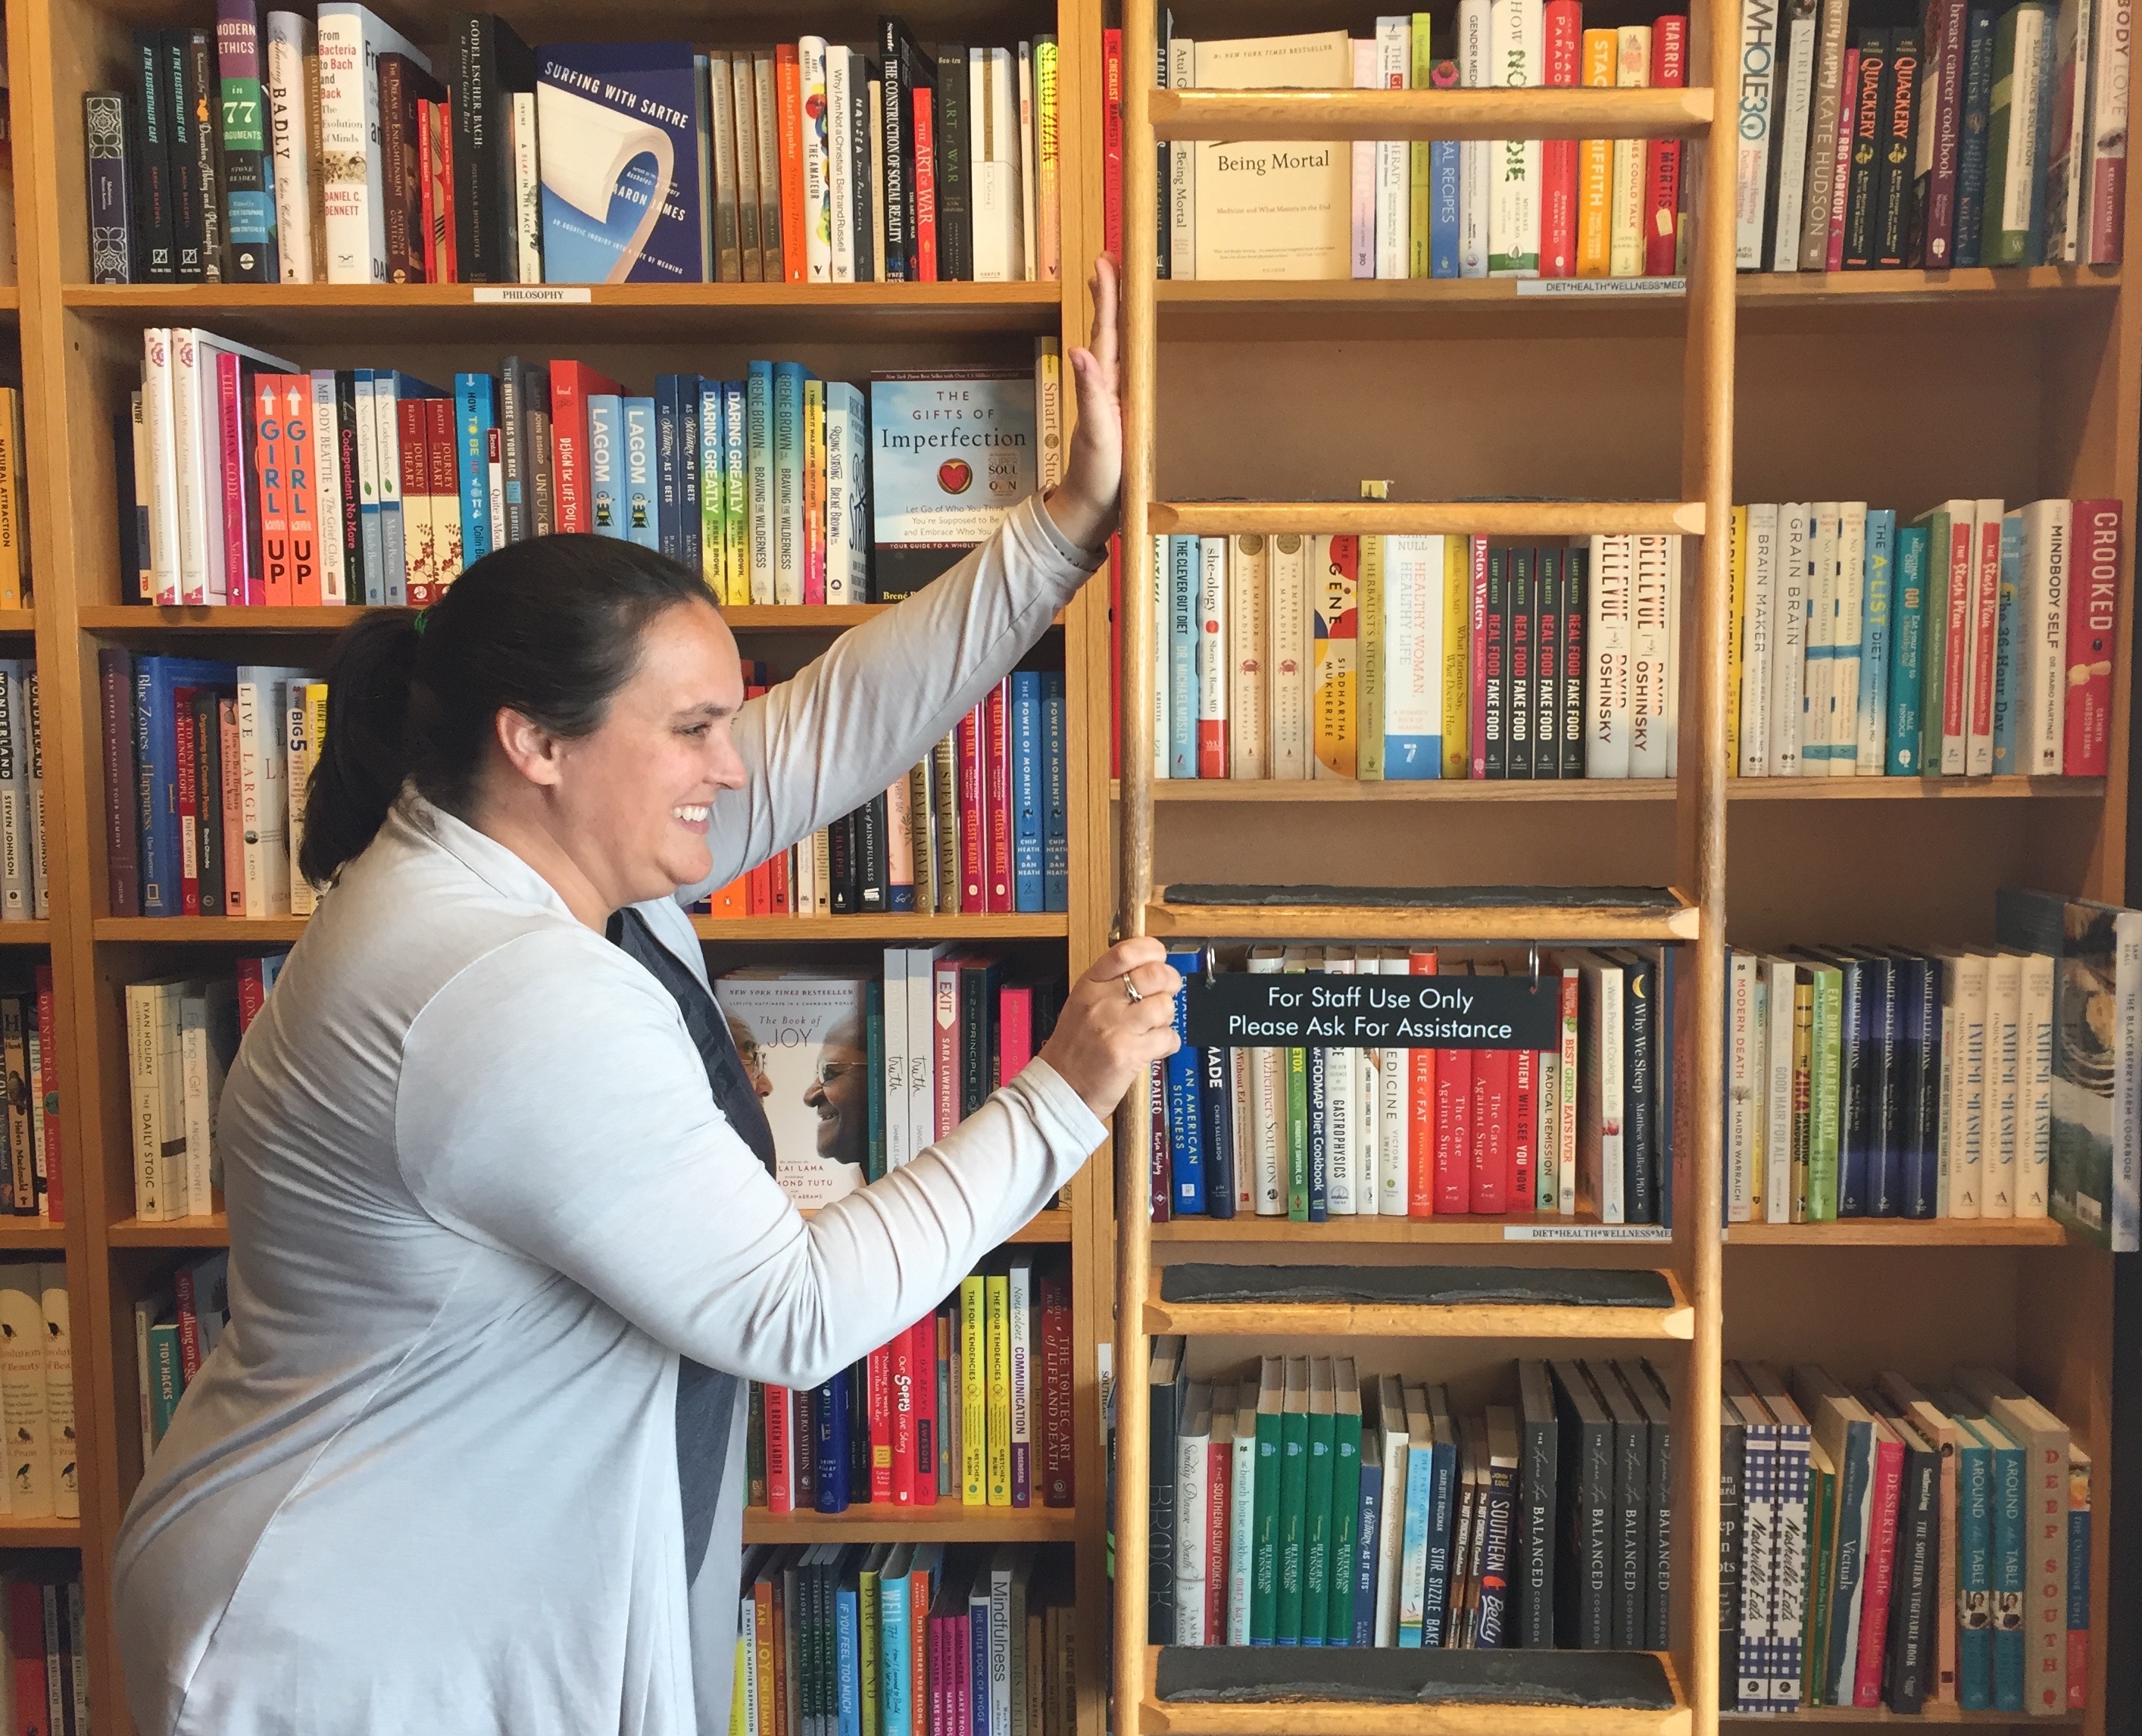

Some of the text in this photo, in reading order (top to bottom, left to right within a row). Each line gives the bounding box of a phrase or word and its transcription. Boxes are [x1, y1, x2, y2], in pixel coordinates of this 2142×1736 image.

[219, 42, 254, 54] ETHICS
[319, 30, 339, 41] From
[319, 44, 356, 55] Bacteria
[320, 59, 352, 70] to Bach
[1664, 22, 1681, 79] HARRIS
[223, 101, 256, 123] 77
[320, 73, 335, 84] and
[320, 88, 341, 98] Back
[545, 61, 688, 129] SURFING WITH SARTRE
[1859, 57, 1884, 140] QUACKERY
[1893, 57, 1917, 139] QUACKERY
[1938, 4, 1964, 179] breast cancer cookbook
[273, 88, 289, 159] BADLY
[323, 120, 362, 129] Evolution
[855, 98, 863, 154] NAUSEA
[885, 59, 901, 244] THE CONSTRUCTION OF SOCIAL REALITY
[1809, 42, 1838, 236] HAPPY KATE HUDSON
[1173, 151, 1187, 185] Being
[1218, 150, 1329, 176] Being Mortal
[1442, 167, 1455, 223] RECIPES
[325, 205, 359, 216] DENNETT
[613, 183, 686, 221] AARON JAMES
[1176, 189, 1187, 228] Mortal
[503, 289, 564, 300] PHILOSOPHY
[317, 383, 331, 432] MELODY
[467, 392, 476, 413] HOW
[912, 410, 995, 420] GIFTS OF
[936, 391, 970, 401] THE
[1043, 382, 1059, 431] Smart
[320, 436, 333, 485] BEATTIE
[414, 442, 424, 489] JOURNEY
[442, 442, 452, 489] JOURNEY
[592, 408, 610, 482] LAGOM
[629, 411, 646, 484] LAGOM
[703, 392, 719, 514] DARING GREATLY
[728, 392, 743, 514] DARING GREATLY
[882, 427, 1027, 454] Imperfection
[342, 429, 357, 549] Codependent No More
[1397, 542, 1428, 551] NULL
[1757, 534, 1769, 585] BRAIN
[2089, 512, 2118, 630] CROOKED
[1176, 540, 1188, 635] THE CLEVER GUT DIET
[1204, 547, 1220, 614] she-ology
[1329, 562, 1344, 625] GENE
[1474, 539, 1488, 630] Detox Waters
[1787, 518, 1803, 645] GRAIN BRAIN
[2047, 525, 2062, 648] MINDBODY SELF
[1753, 594, 1768, 653] MAKER
[1325, 661, 1333, 738] MUKHERJEE
[1337, 657, 1345, 742] SIDDHARTHA
[1486, 614, 1501, 741] REAL FOOD FAKE FOOD
[1513, 615, 1528, 742] REAL FOOD FAKE FOOD
[1599, 654, 1613, 743] OSHINSKY
[1635, 661, 1648, 752] OSHINSKY
[1995, 702, 2007, 732] Day
[2047, 701, 2055, 741] MARTINEZ
[241, 687, 257, 823] LIVE LARGE
[1404, 744, 1417, 763] 7
[5, 826, 14, 876] JOHNSON
[914, 772, 929, 887] STEVE HARVEY
[940, 770, 954, 887] STEVE HARVEY
[939, 981, 953, 1013] EXIT
[1229, 1016, 1513, 1038] Please Ask For Assistance
[1268, 986, 1474, 1013] For Staff Use Only
[1735, 978, 1747, 1079] MODERN DEATH
[143, 1031, 152, 1076] HOLIDAY
[767, 1028, 813, 1048] JOY
[1632, 1002, 1647, 1094] Why We Sleep
[1173, 1085, 1185, 1150] SICKNESS
[1185, 1069, 1198, 1164] AN AMERICAN
[1474, 1076, 1488, 1171] Against Sugar
[1544, 1066, 1554, 1176] RADICAL REMISSION
[1563, 1038, 1576, 1163] BEST GREEN EATS EVER
[1794, 1070, 1810, 1110] ZIKA
[142, 1113, 155, 1188] DAILY STOIC
[1313, 1112, 1324, 1191] Diet Cookbook
[1332, 1100, 1346, 1179] GASTROPHYSICS
[1438, 1080, 1450, 1173] Against Sugar
[1014, 1347, 1026, 1435] COMMUNICATION
[1061, 1433, 1071, 1462] ART
[1212, 1482, 1222, 1591] SOUTHERN COOKER
[1486, 1500, 1510, 1572] SOUTHERN
[1532, 1507, 1544, 1588] BALANCED
[1591, 1509, 1604, 1591] BALANCED
[1624, 1510, 1637, 1591] BALANCED
[1972, 1458, 1983, 1586] AROUND TABLE
[2005, 1459, 2017, 1587] AROUND TABLE
[1839, 1539, 1857, 1591] Victuals
[993, 1581, 1010, 1682] Mindfulness
[1480, 1594, 1504, 1644] Belly
